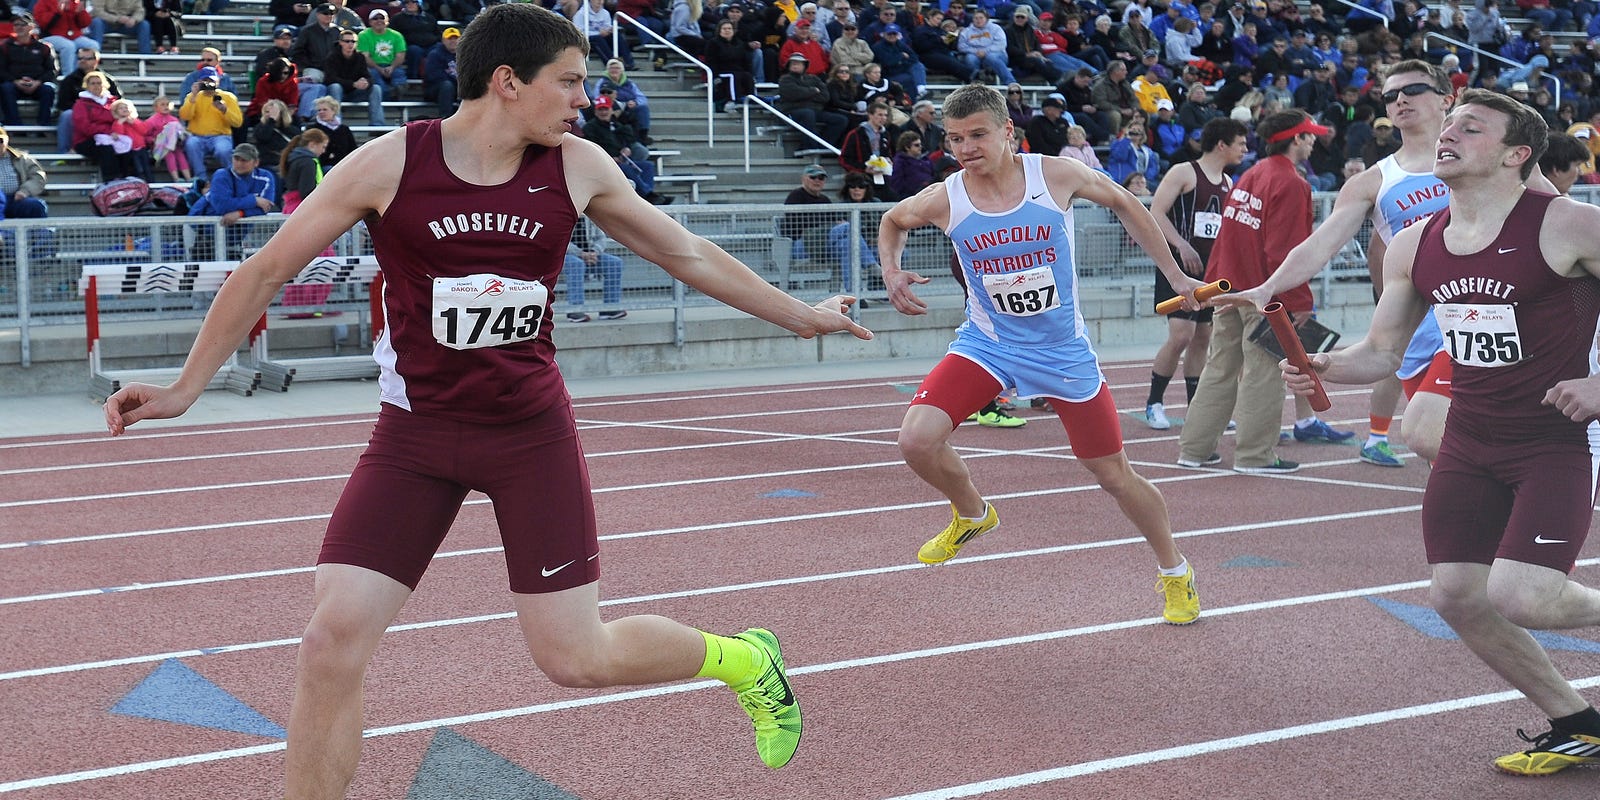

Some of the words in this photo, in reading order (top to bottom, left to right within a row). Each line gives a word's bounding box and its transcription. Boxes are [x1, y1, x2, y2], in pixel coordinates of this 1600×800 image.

[428, 212, 544, 240] ROOSEVELT
[964, 225, 1052, 254] LINCOLN
[972, 246, 1057, 274] PATRIOTS
[992, 285, 1055, 314] 1637
[1432, 277, 1515, 303] ROOSEVELT
[440, 304, 542, 344] 1743
[1446, 330, 1520, 363] 1735
